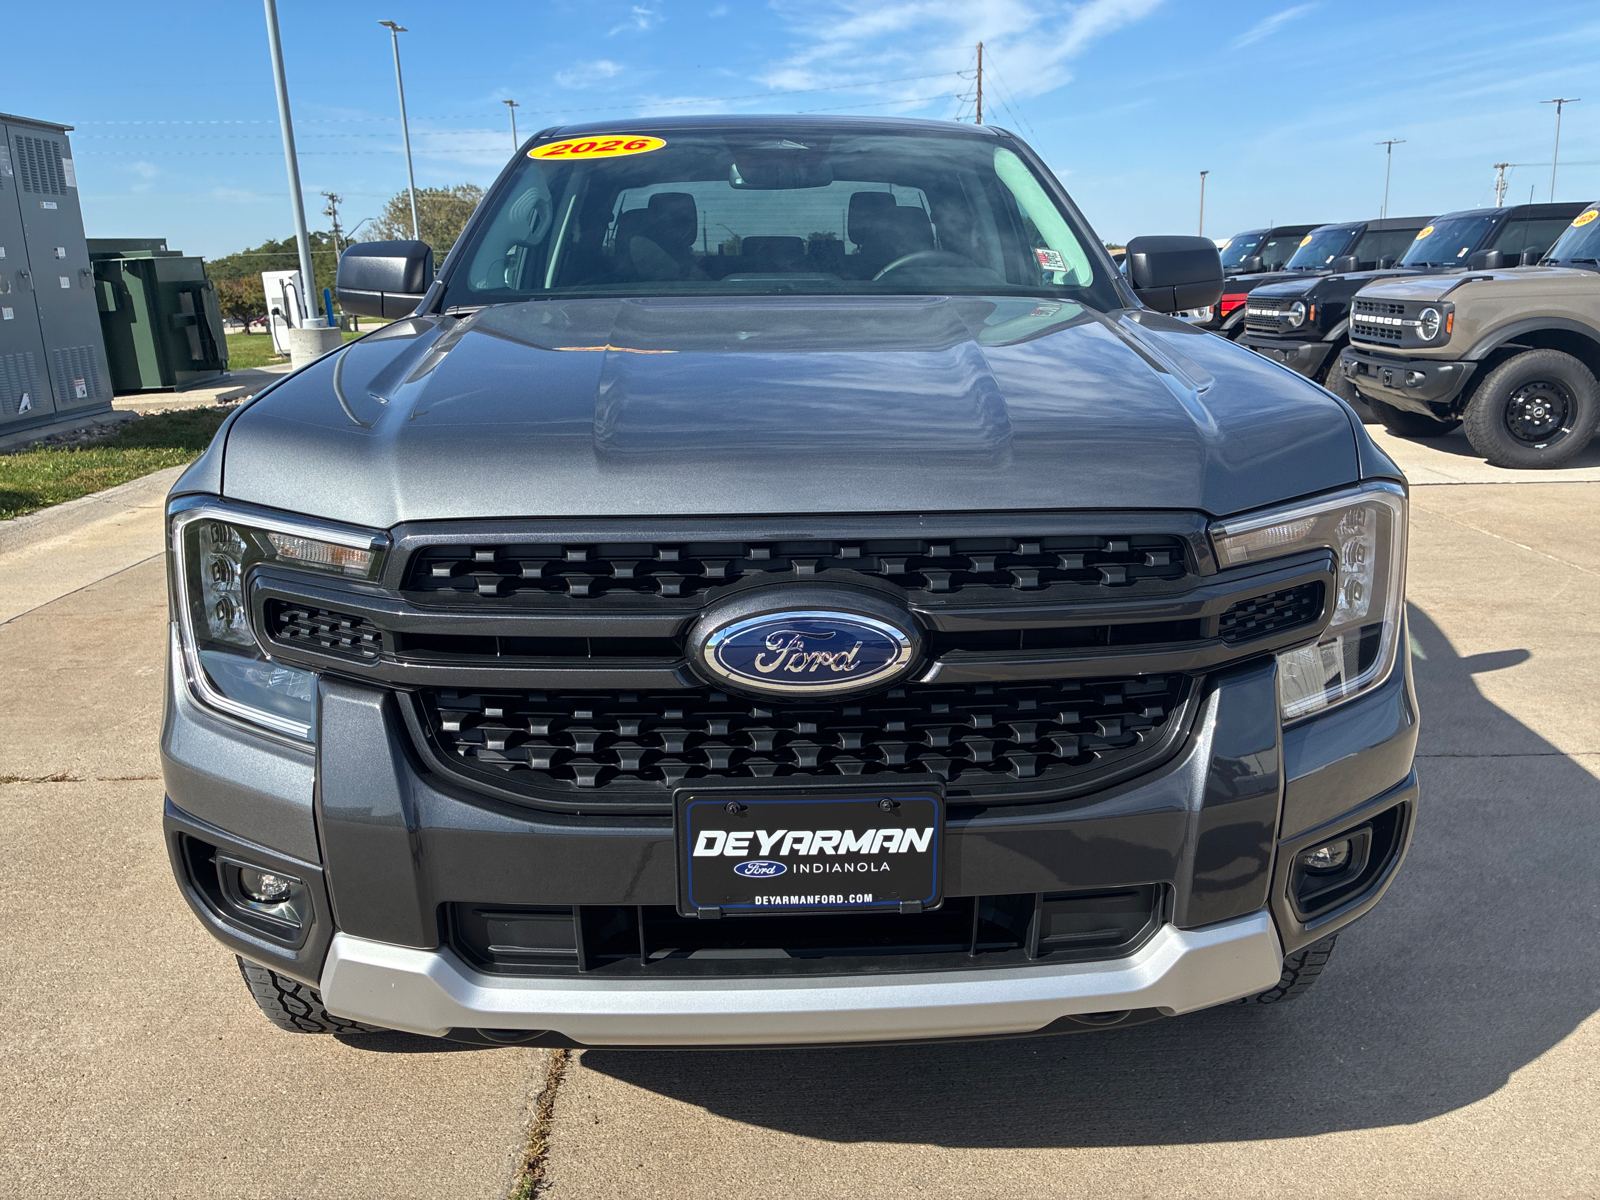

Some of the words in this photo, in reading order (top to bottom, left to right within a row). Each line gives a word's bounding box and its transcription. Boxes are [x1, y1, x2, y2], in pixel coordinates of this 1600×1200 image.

[541, 139, 652, 157] 2026
[754, 630, 861, 673] Ford
[692, 827, 934, 857] DEYARMAN
[744, 862, 776, 875] Ford
[793, 862, 890, 874] INDIANOLA
[755, 893, 873, 905] DEYARMANFORD.COM
